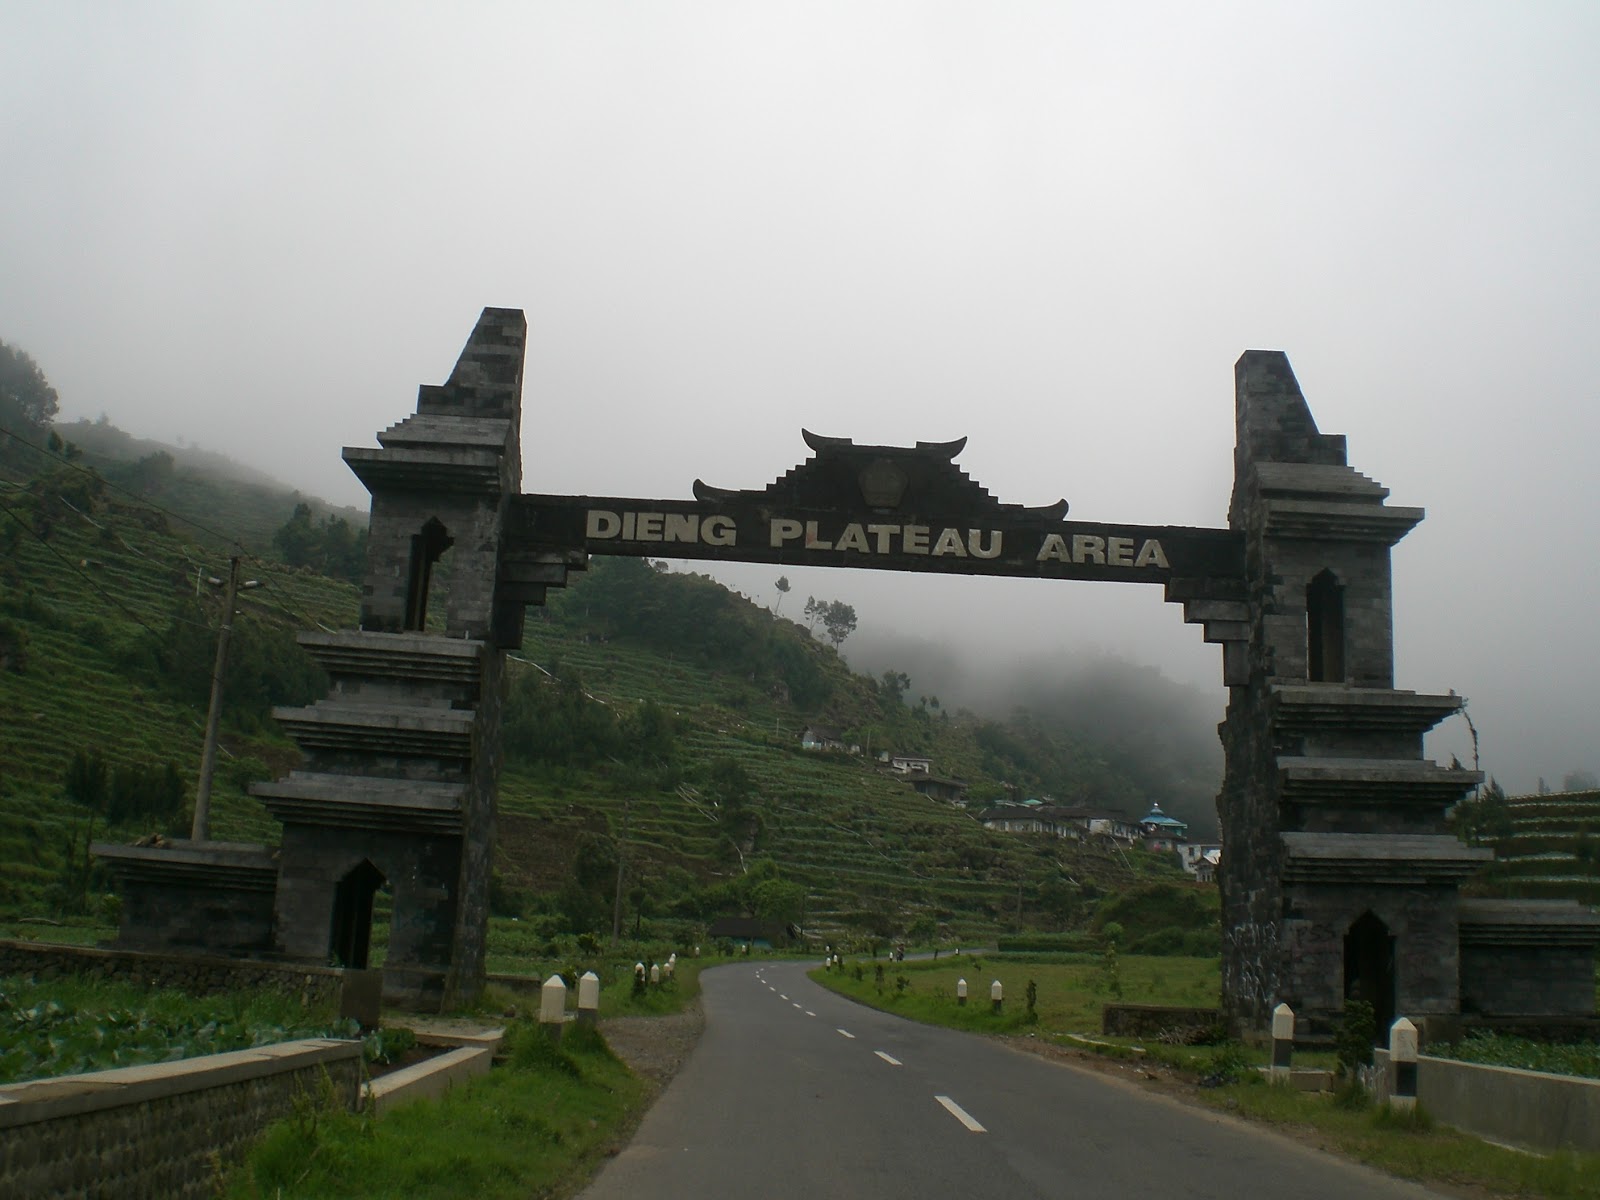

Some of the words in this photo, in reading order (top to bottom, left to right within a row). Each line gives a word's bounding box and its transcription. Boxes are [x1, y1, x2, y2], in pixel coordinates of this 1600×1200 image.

[586, 510, 738, 547] DIENG
[769, 519, 1003, 559] PLATEAU
[1036, 533, 1170, 569] AREA
